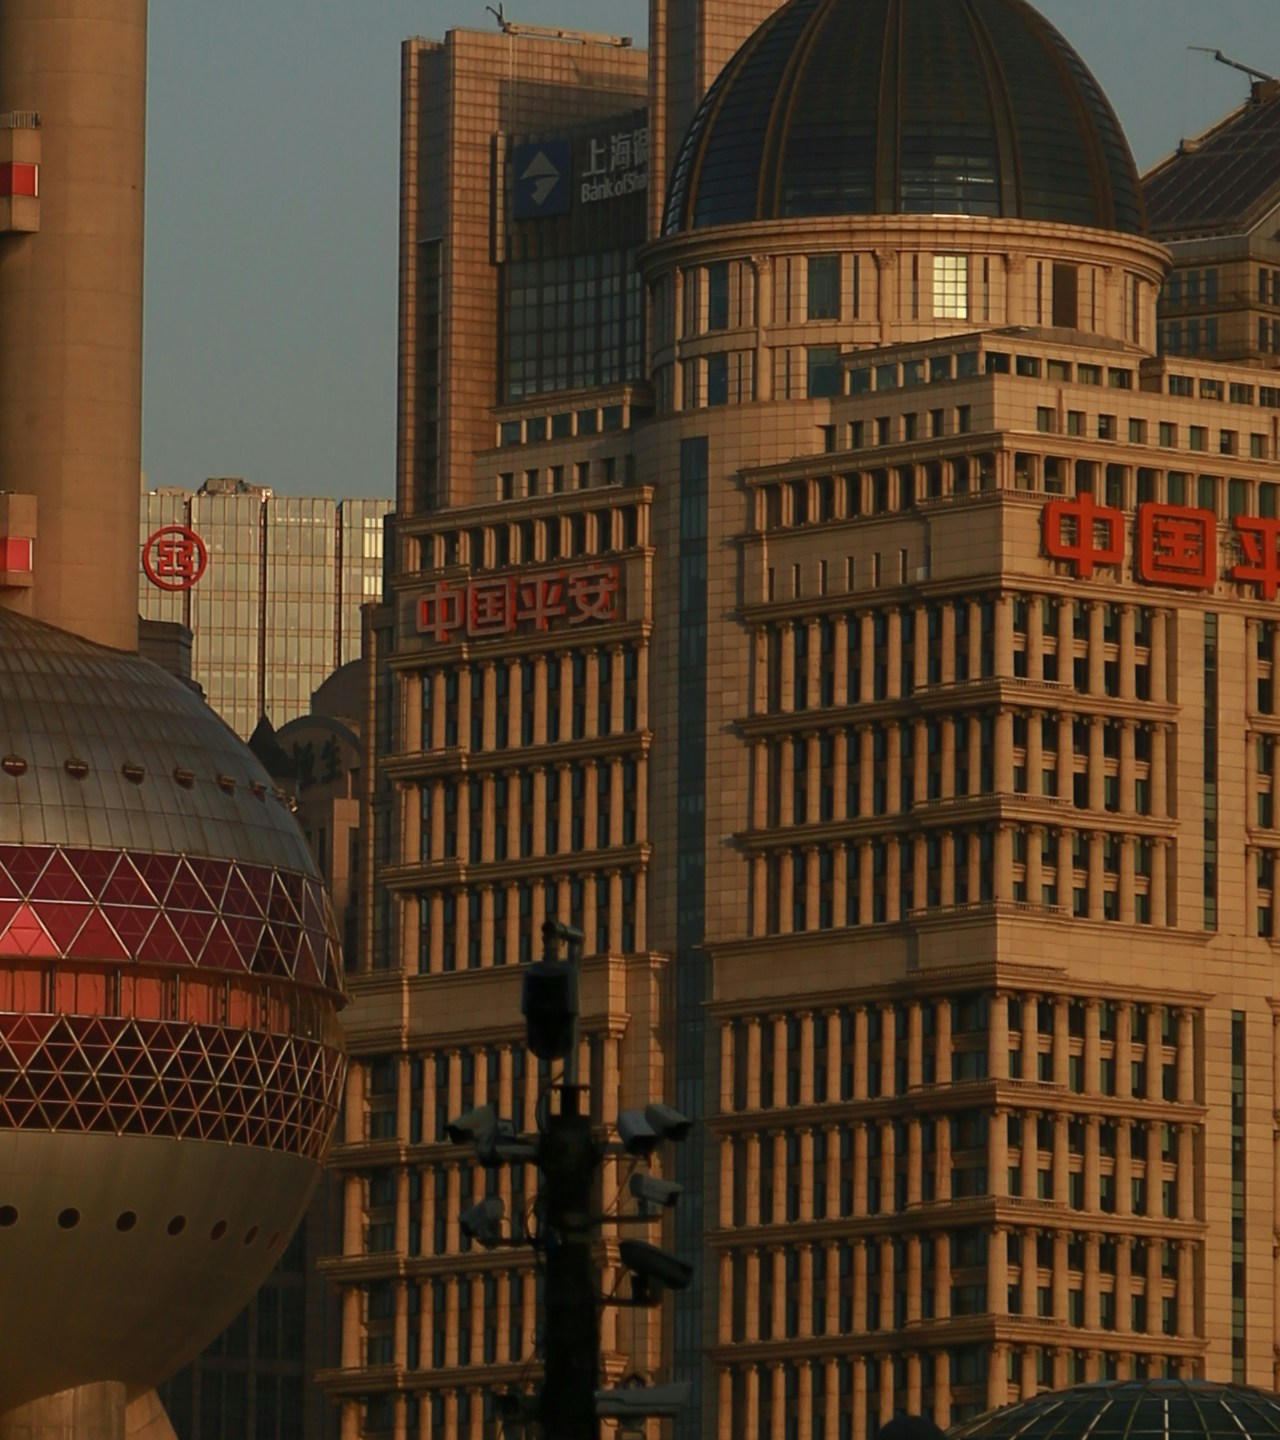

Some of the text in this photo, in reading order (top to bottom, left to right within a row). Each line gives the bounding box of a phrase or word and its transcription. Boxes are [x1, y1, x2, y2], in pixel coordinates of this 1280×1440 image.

[582, 176, 613, 203] Bank
[417, 563, 619, 643] 中国平安
